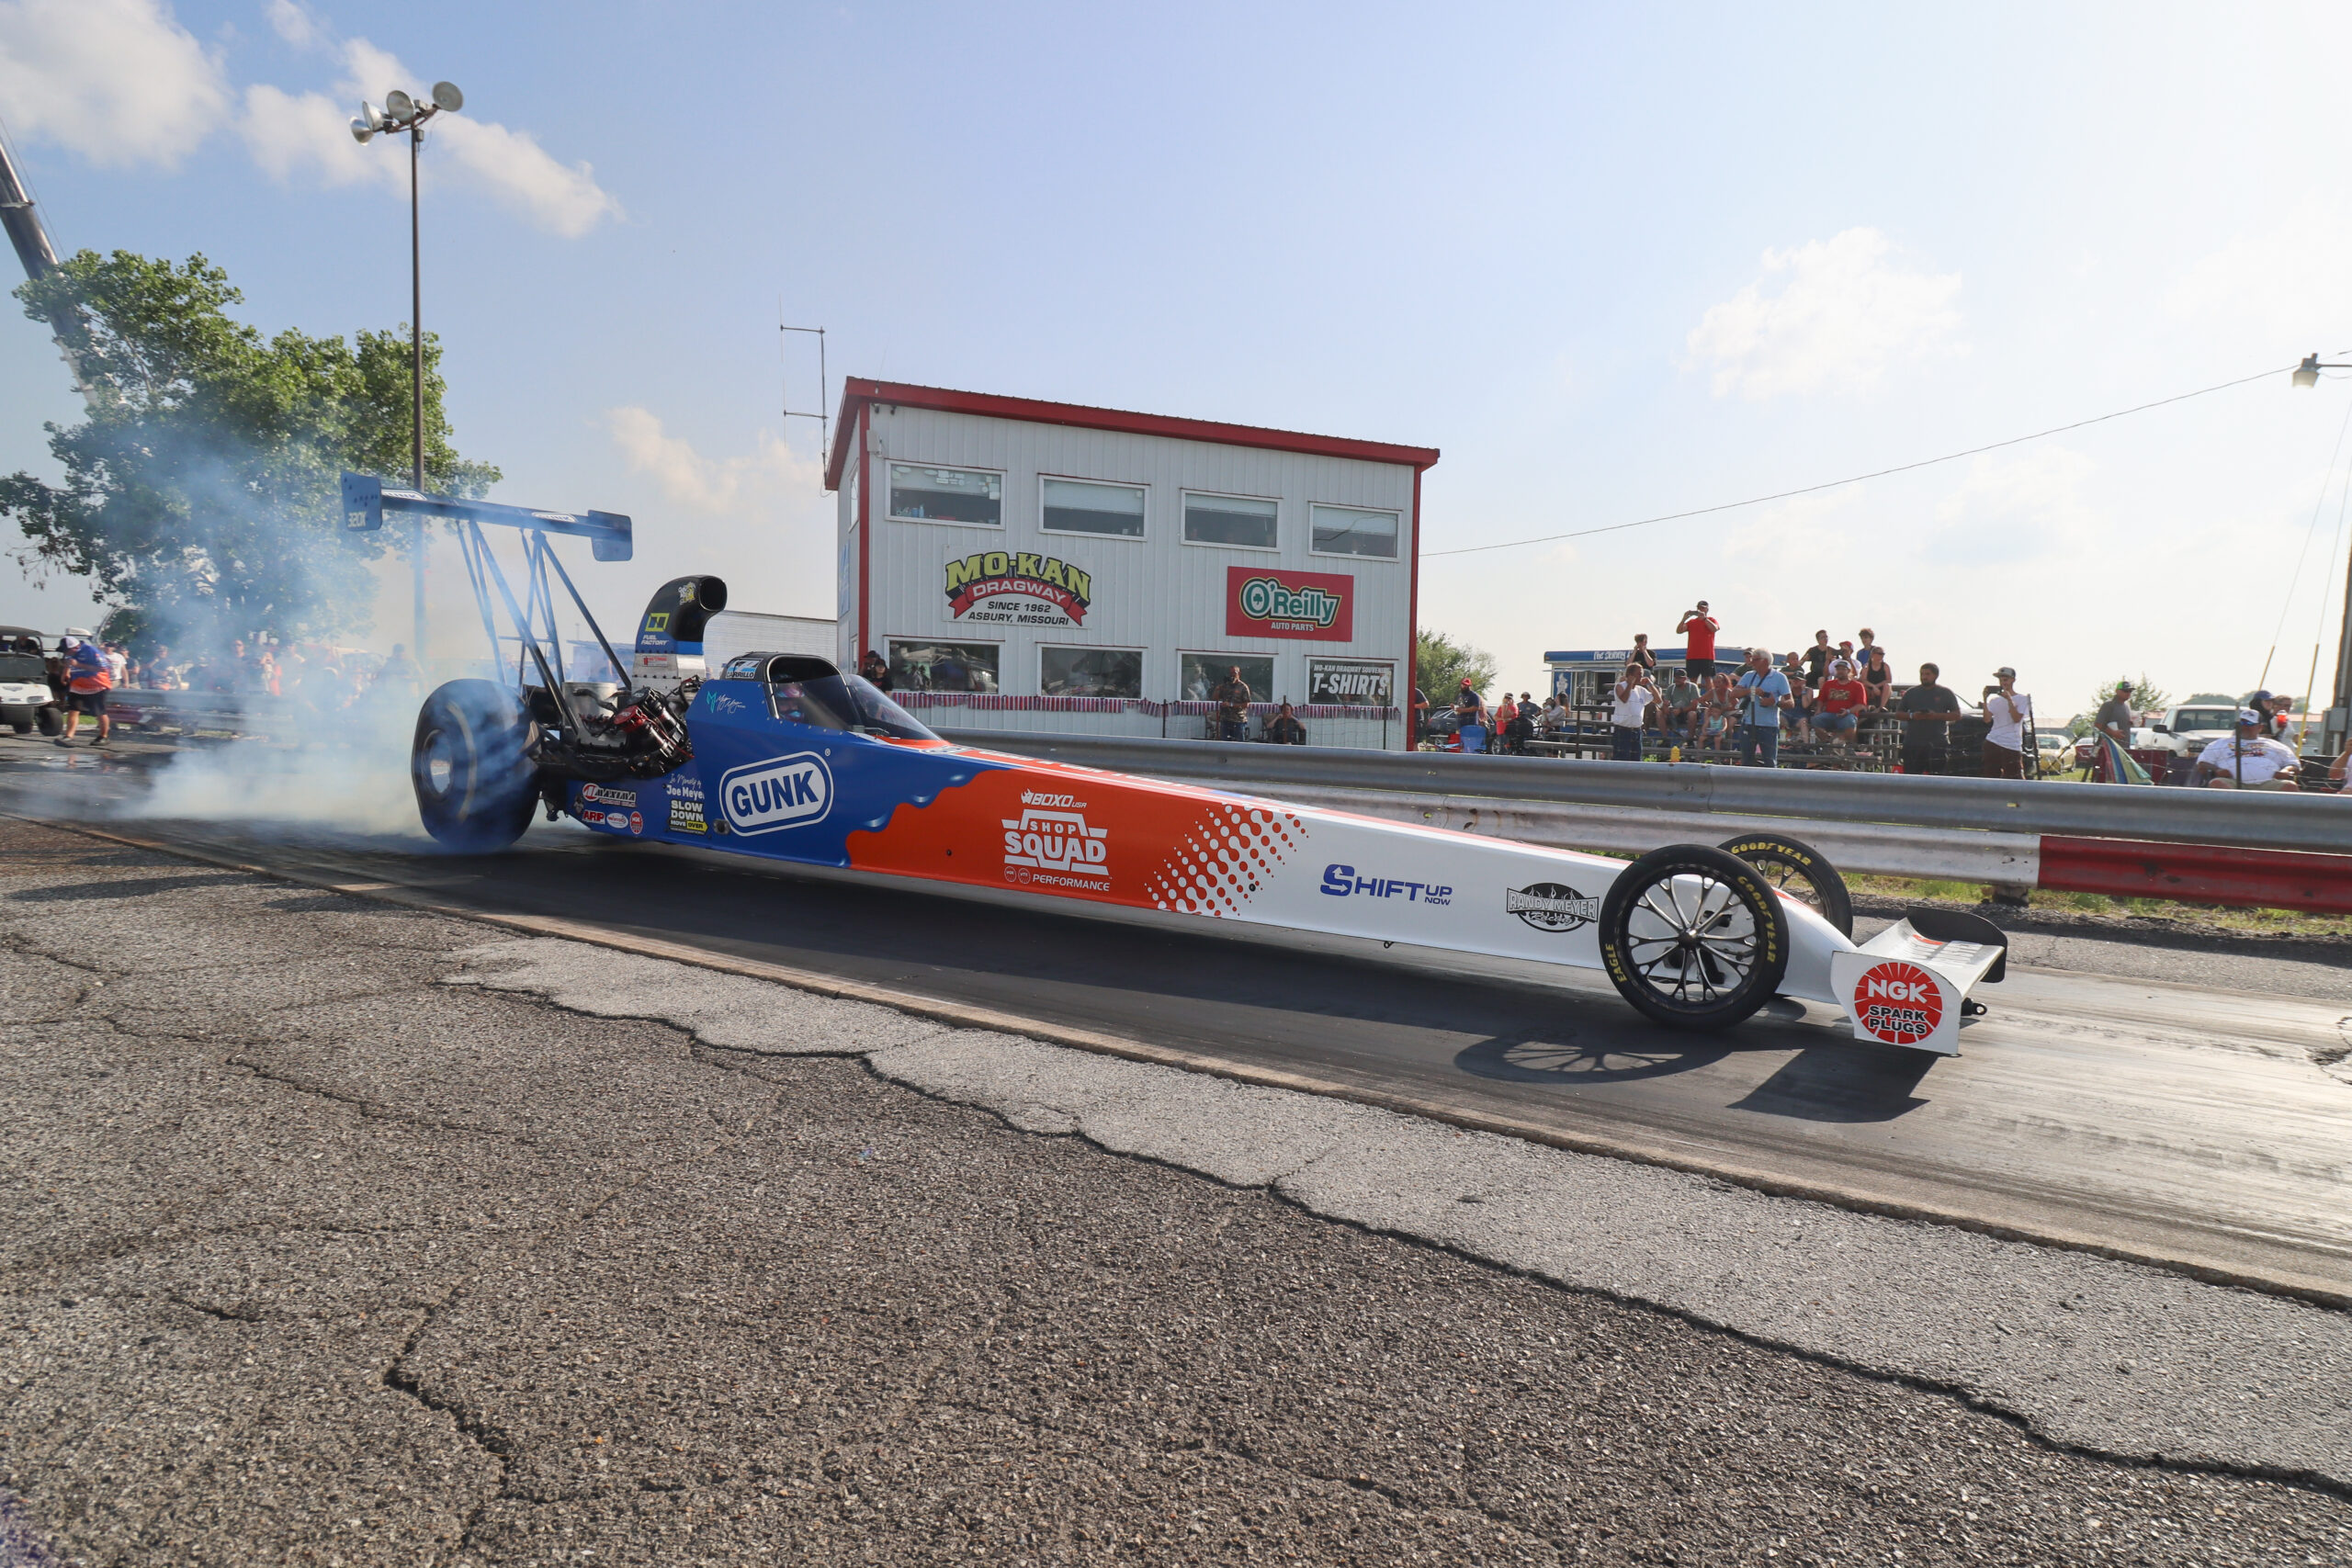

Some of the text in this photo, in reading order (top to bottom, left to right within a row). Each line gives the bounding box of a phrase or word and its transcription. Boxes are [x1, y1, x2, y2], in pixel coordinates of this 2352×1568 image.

[945, 551, 1091, 606] MO-KAN
[972, 580, 1067, 604] DRAGWAY
[987, 601, 1052, 613] SINCE 1962
[1244, 581, 1336, 623] O'Reilly
[967, 611, 1069, 626] ASBURY, MISSOURI
[1271, 621, 1315, 632] AUTO PARTS
[1313, 664, 1336, 672] MO-KAN
[1336, 665, 1362, 673] DRAGWAY
[1313, 672, 1390, 696] T-SHIRTS
[666, 784, 682, 796] Joe
[731, 770, 820, 818] GUNK
[671, 799, 704, 813] SLOW
[1031, 793, 1075, 808] BOXO
[582, 810, 605, 822] ARP
[671, 809, 705, 822] DOWN
[1029, 820, 1077, 835] SHOP
[1003, 830, 1107, 864] SQUAD
[1032, 874, 1111, 892] PERFORMANCE
[1319, 863, 1453, 902] SHIFT UP
[1423, 895, 1452, 907] NOW
[1509, 892, 1597, 919] RANDY MEYER
[1530, 911, 1574, 927] Racing
[1605, 942, 1628, 983] EAGLE
[1867, 978, 1928, 1005] NGK
[1869, 1005, 1927, 1023] SPARK
[1869, 1017, 1928, 1035] PLUGS
